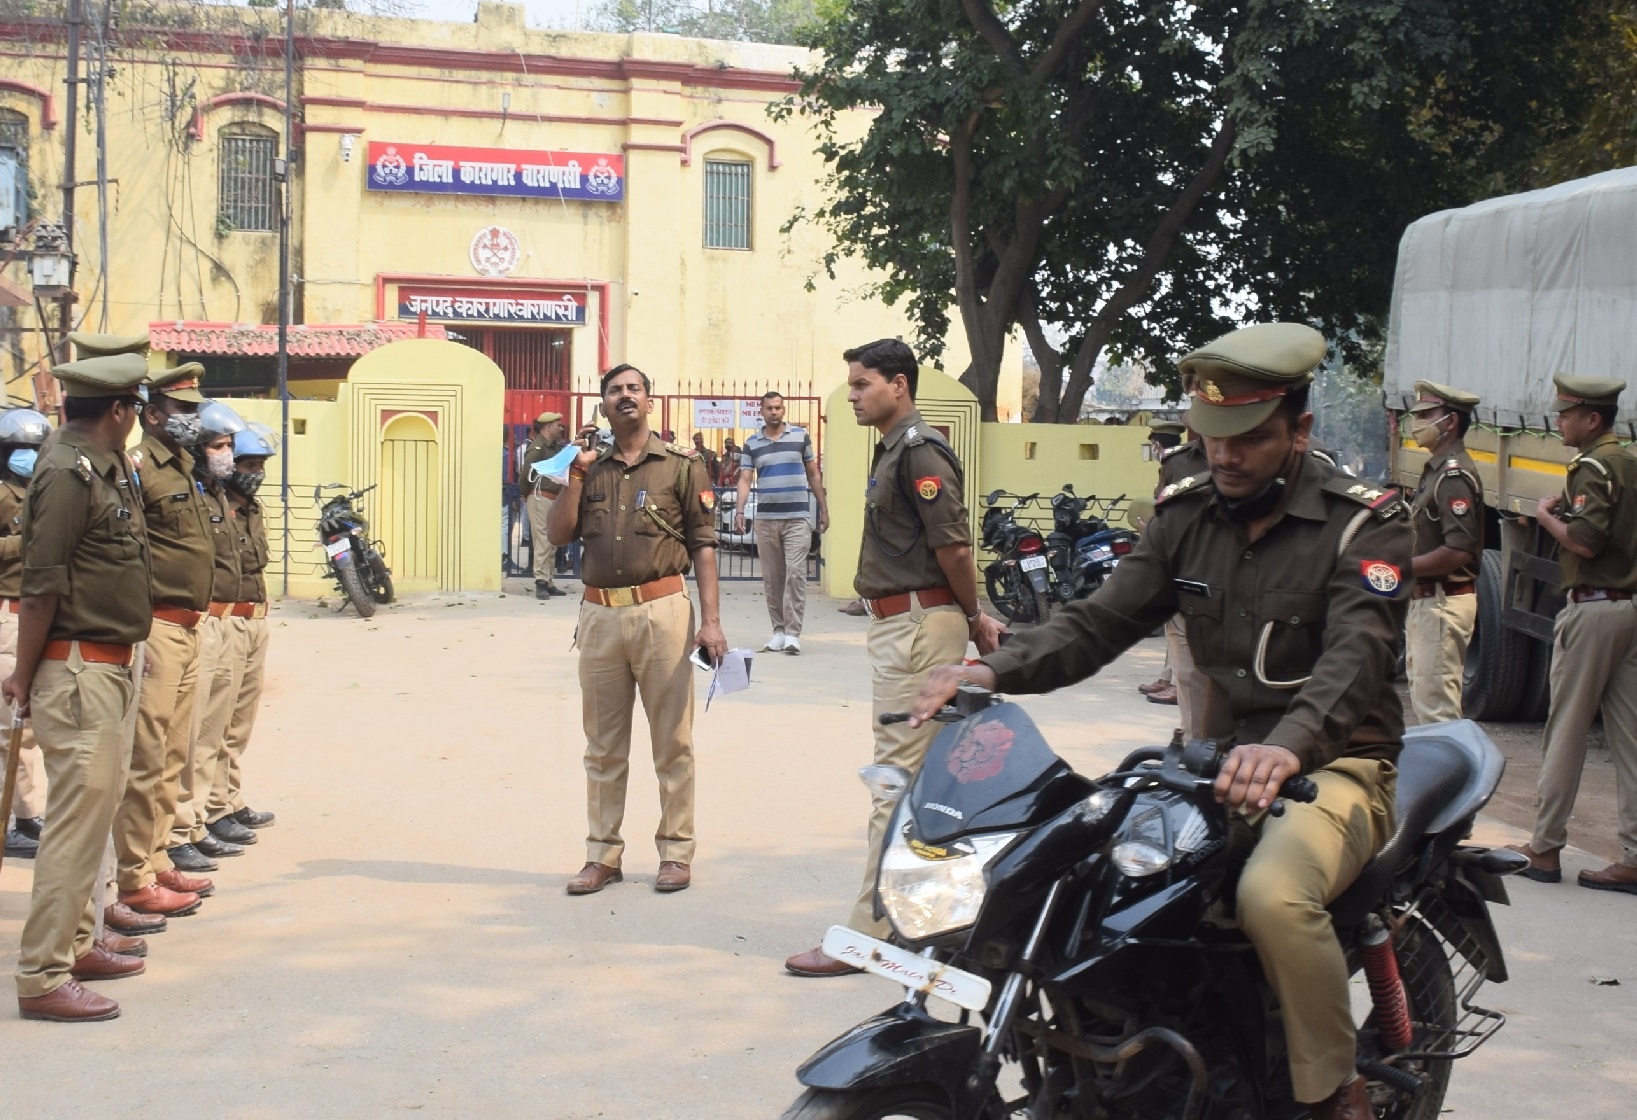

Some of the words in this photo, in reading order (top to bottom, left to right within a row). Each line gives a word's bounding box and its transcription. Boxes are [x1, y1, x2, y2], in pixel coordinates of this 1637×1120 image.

[413, 152, 454, 183] जिला
[459, 161, 516, 186] कारागार
[521, 160, 582, 189] वाराणसी
[406, 295, 454, 318] जनपद
[454, 297, 517, 319] कारागार
[516, 294, 578, 321] वाराणसी
[924, 802, 963, 820] HONDA
[840, 945, 867, 961] Jai
[880, 959, 925, 981] Mata
[935, 979, 957, 995] Di
